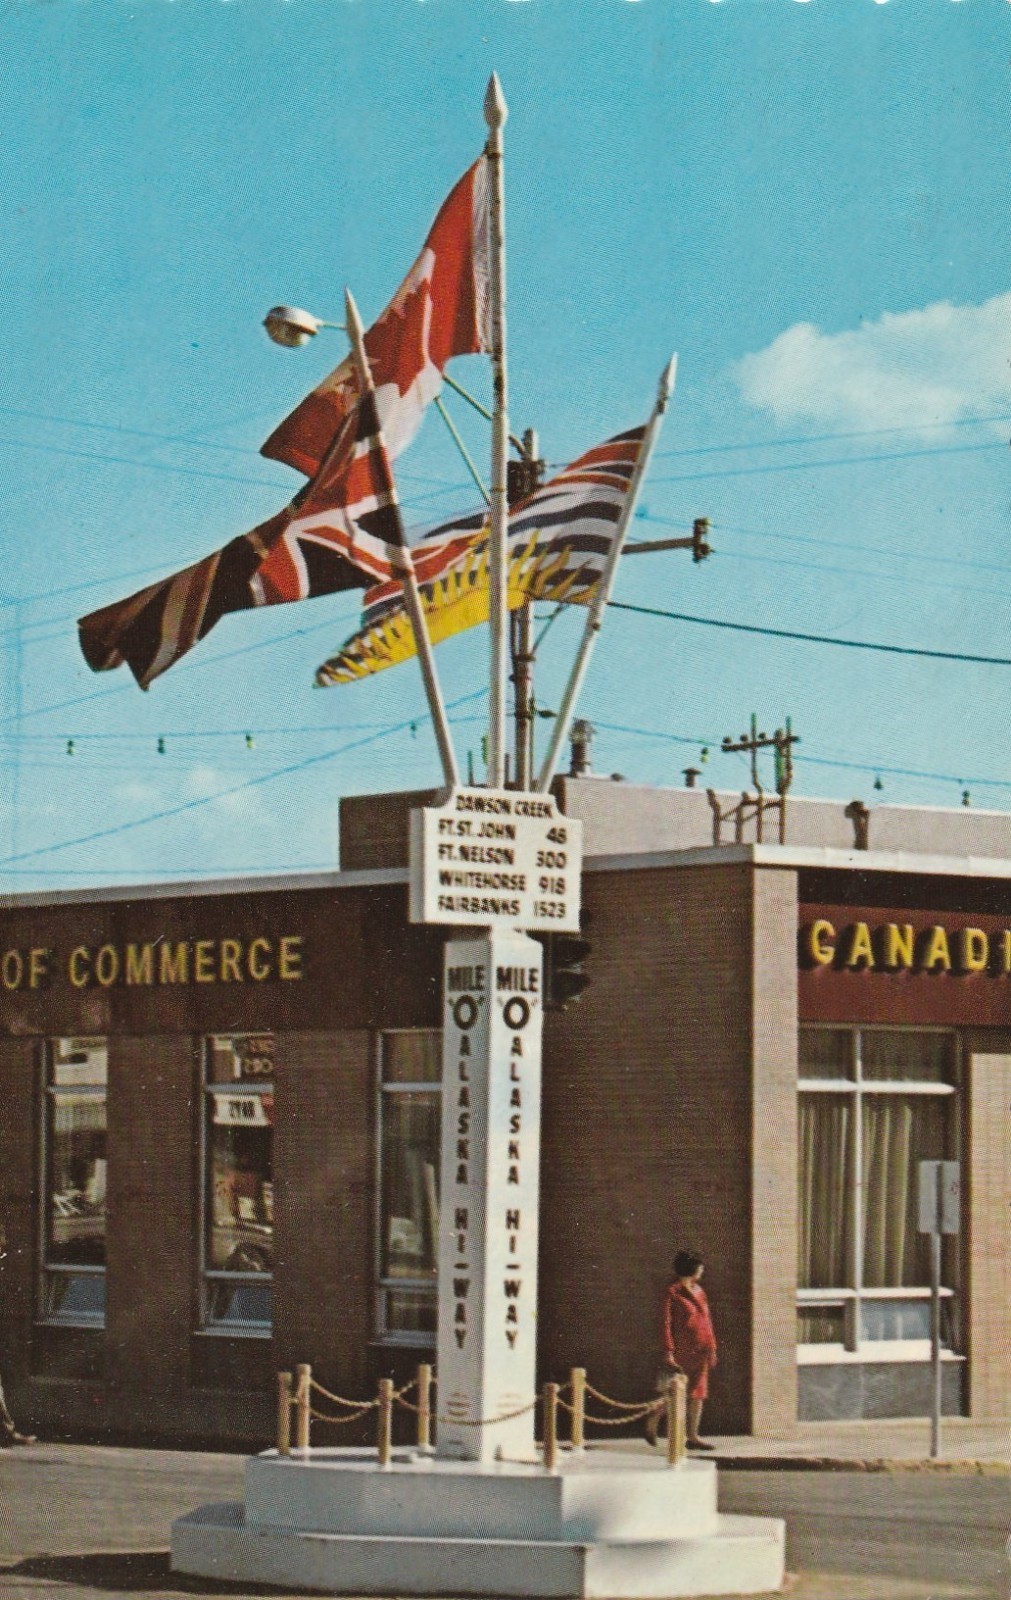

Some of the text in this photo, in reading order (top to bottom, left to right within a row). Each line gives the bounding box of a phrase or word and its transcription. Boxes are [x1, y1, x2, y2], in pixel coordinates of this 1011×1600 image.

[456, 794, 553, 819] DAWSON CREEK
[536, 850, 568, 869] 300
[438, 869, 566, 895] WHITEHORSE 918
[438, 894, 566, 919] FAIRBANKS 1523
[1, 936, 302, 989] OF COMMERCE
[447, 965, 485, 992] MILE
[496, 965, 539, 992] MILE
[455, 1034, 471, 1186] ALASKA
[507, 1035, 523, 1186] ALASKA
[453, 1207, 471, 1350] HI-WAY
[503, 1208, 522, 1351] HI-WAY
